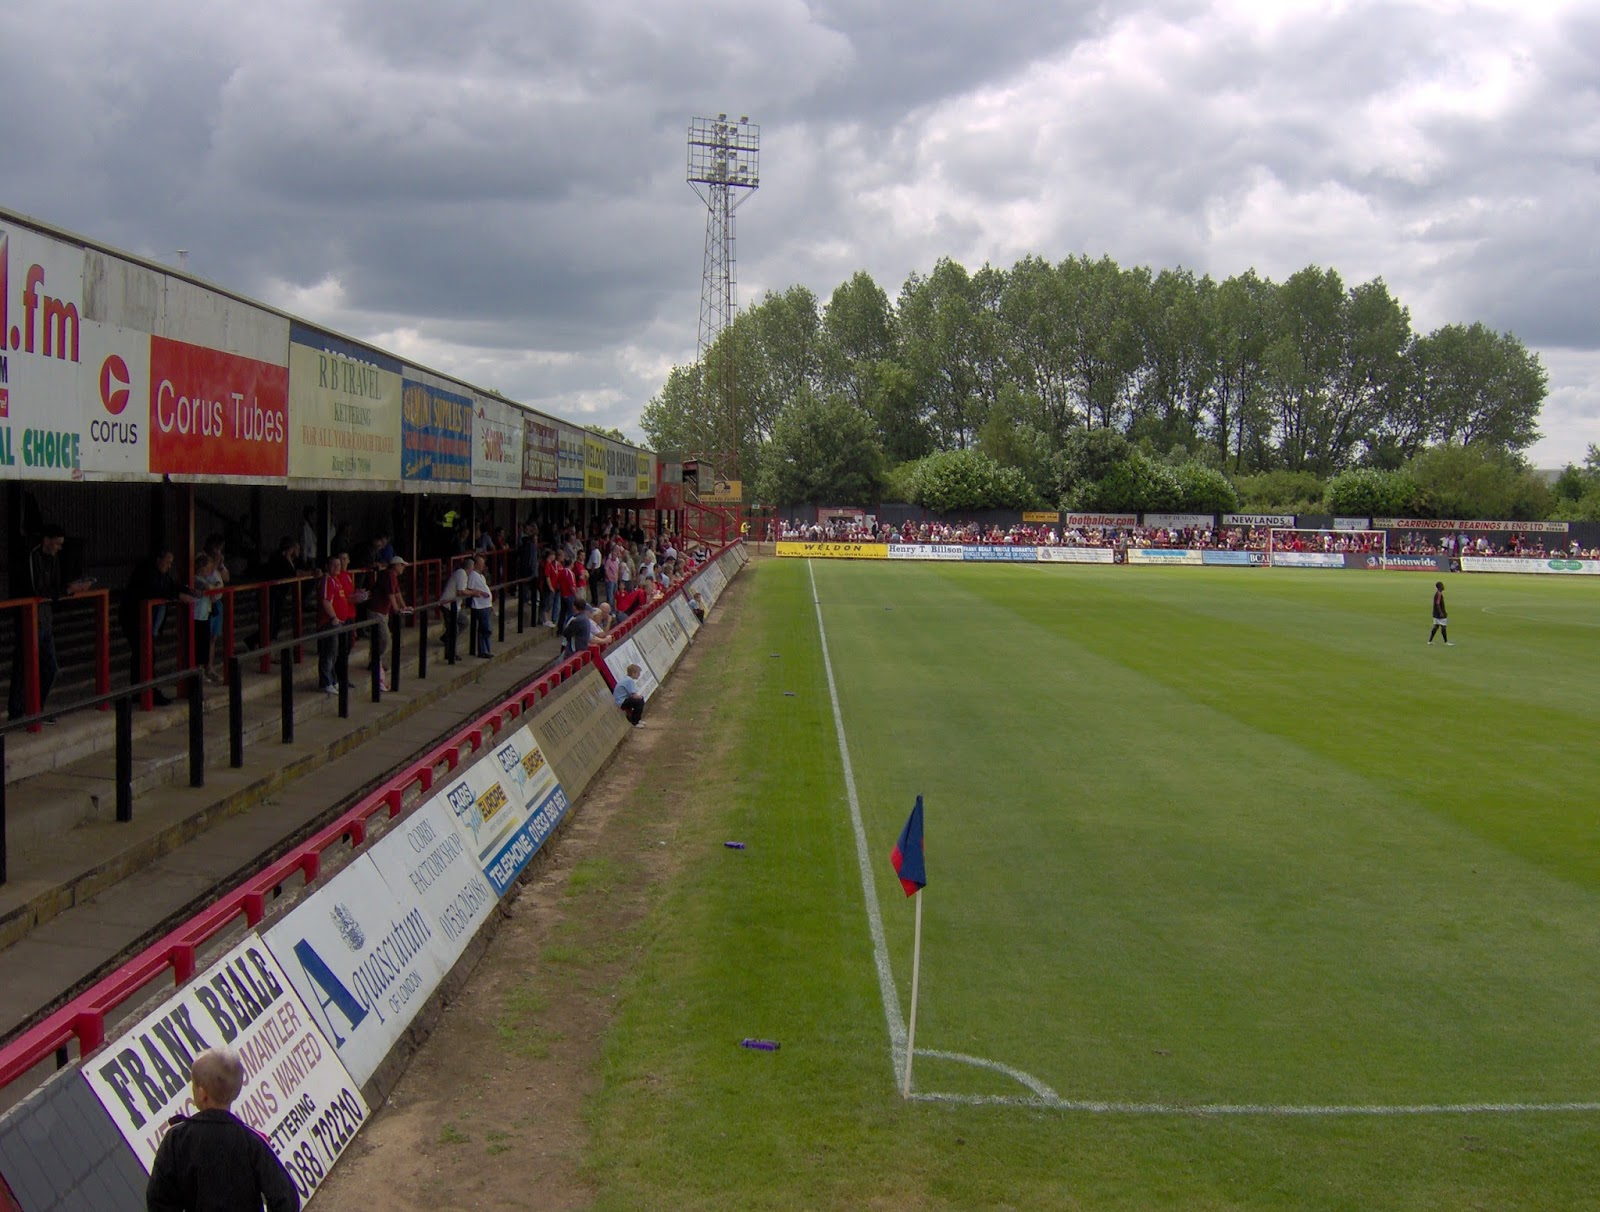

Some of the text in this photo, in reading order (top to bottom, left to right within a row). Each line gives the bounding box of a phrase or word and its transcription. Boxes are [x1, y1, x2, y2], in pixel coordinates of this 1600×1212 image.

[342, 361, 382, 401] TRAVEL
[157, 379, 284, 443] Corus Tubes
[23, 428, 80, 469] CHOICE
[90, 419, 138, 444] corus
[1231, 516, 1285, 525] NEWLANDS
[1397, 520, 1455, 529] CARRINGTON
[1459, 521, 1501, 531] BEARINGS
[1511, 522, 1529, 531] ENG
[1530, 523, 1544, 532] LTD
[804, 543, 862, 552] WELDON
[889, 545, 916, 554] Henry
[931, 545, 962, 553] Billson
[1378, 557, 1436, 567] Nationwide
[449, 783, 474, 815] CARS
[477, 786, 507, 818] EUROPE
[407, 817, 438, 854] CORBY
[409, 832, 465, 895] FACTORY SHOP
[489, 833, 535, 889] TELEPHONE:
[293, 907, 433, 1051] Aquascutum
[398, 970, 424, 1007] LONDON
[98, 947, 285, 1131] FRANK BEALE
[238, 1001, 303, 1088] SMANTLER
[271, 1031, 324, 1101] WANTED
[267, 1092, 317, 1157] ETTERING
